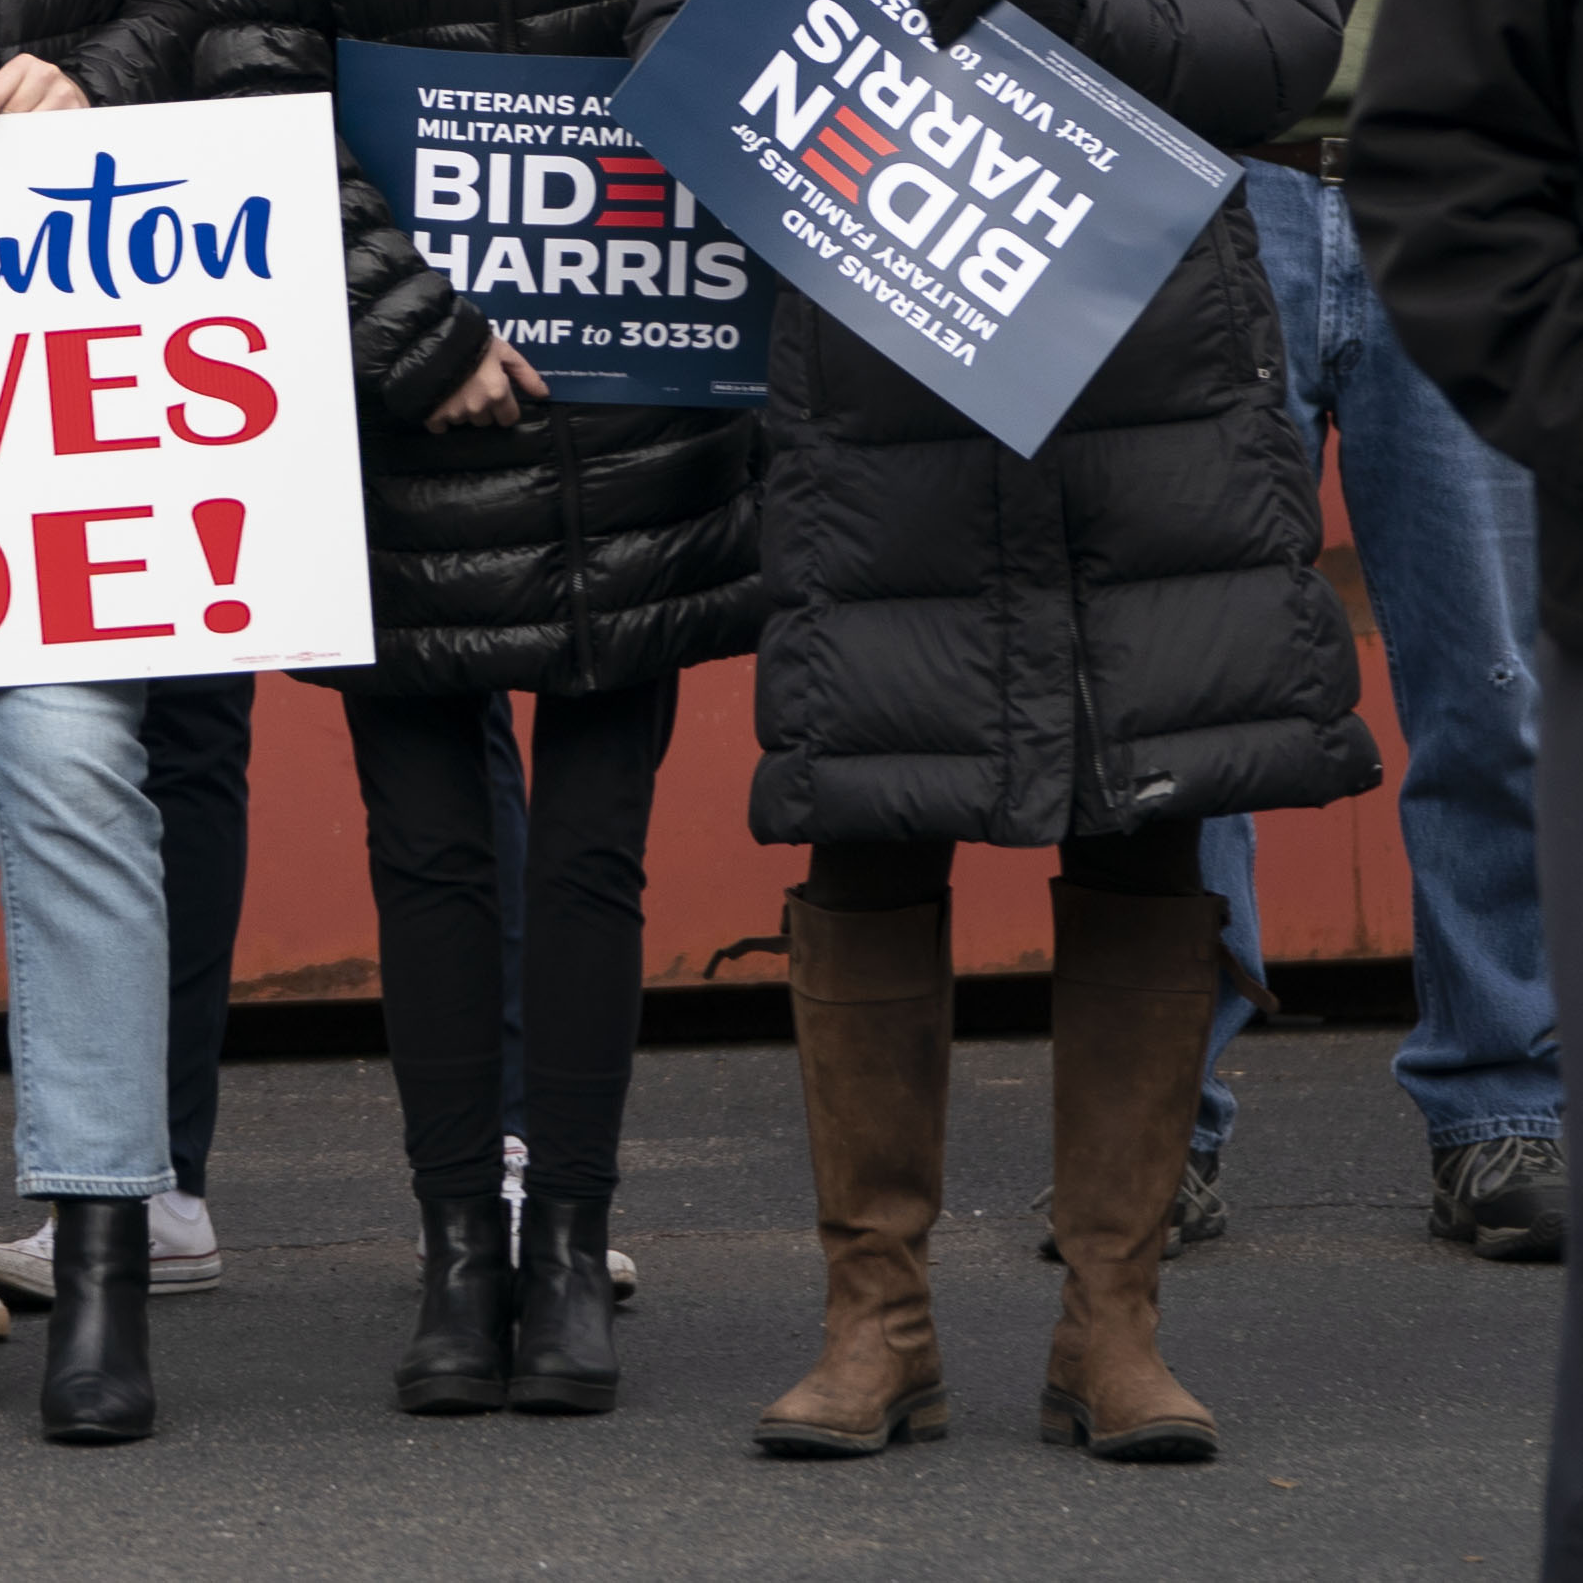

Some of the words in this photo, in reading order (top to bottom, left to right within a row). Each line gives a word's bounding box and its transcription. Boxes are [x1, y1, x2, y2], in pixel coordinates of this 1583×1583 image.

[949, 44, 982, 71] to
[417, 87, 576, 115] VETERANS
[975, 71, 1054, 133] VMF
[417, 118, 555, 144] MILITARY
[731, 123, 772, 153] for
[1055, 119, 1120, 173] Text
[739, 49, 1051, 317] BIDEN
[759, 148, 877, 250] FAMILIES
[782, 209, 843, 259] AND
[412, 231, 749, 300] HARRIS
[838, 254, 977, 367] VETERANS
[871, 246, 999, 341] MILITARY
[581, 322, 612, 346] to
[619, 320, 740, 349] 30330
